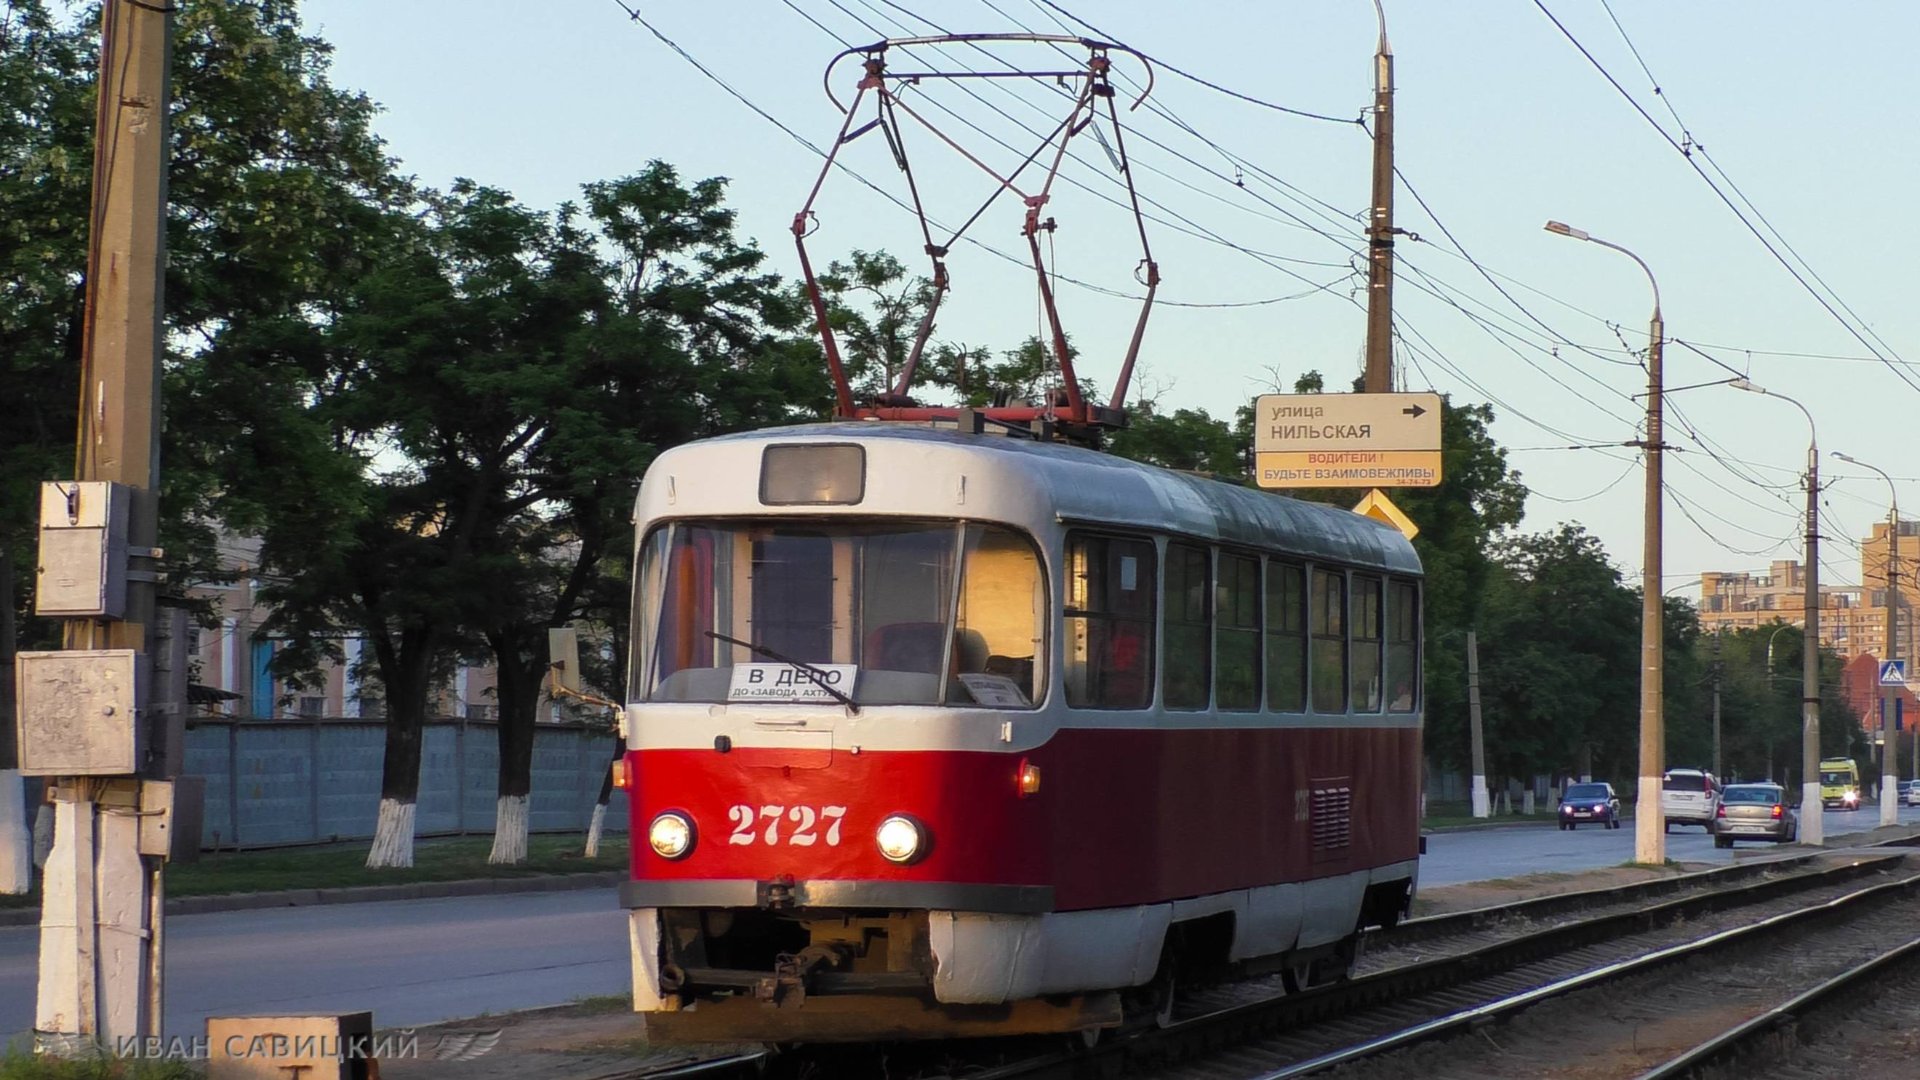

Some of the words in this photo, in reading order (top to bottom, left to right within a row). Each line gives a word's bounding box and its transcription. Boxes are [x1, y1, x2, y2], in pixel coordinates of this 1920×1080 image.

[1272, 406, 1324, 421] улица
[1271, 424, 1371, 439] НИЛЬСКАЯ
[1308, 453, 1377, 464] ВОДИТЕЛИ
[1264, 469, 1310, 480] БУДЬТЕ
[1315, 468, 1435, 479] ВЗАИМОВЕЖЛИВЫ
[748, 669, 764, 683] В
[775, 669, 842, 687] ДЕПО
[732, 688, 748, 697] ДО
[728, 805, 847, 846] 2727
